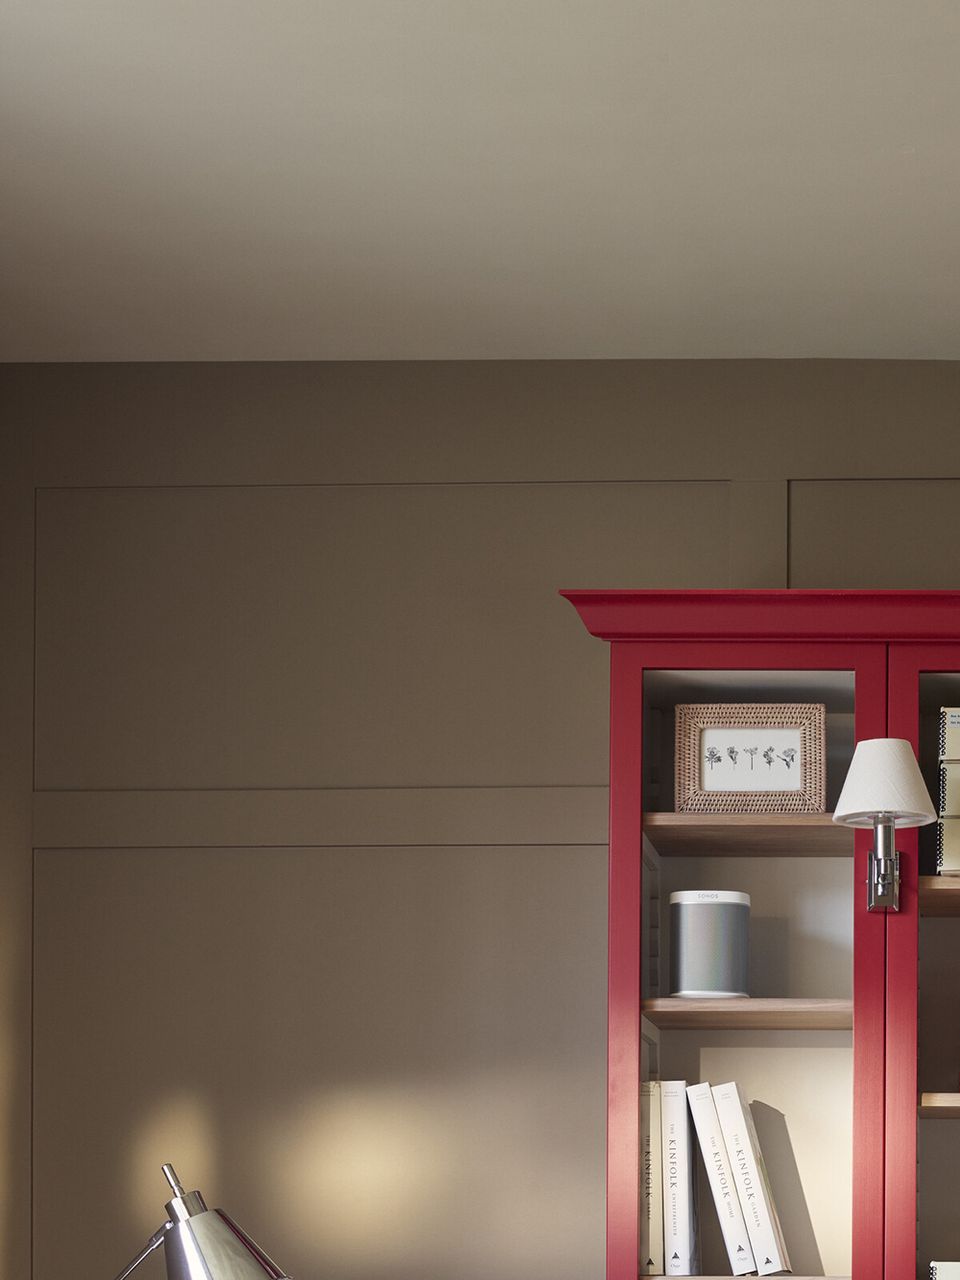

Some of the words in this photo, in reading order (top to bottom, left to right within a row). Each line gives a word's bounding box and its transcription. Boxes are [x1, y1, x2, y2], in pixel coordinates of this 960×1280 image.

[644, 1151, 653, 1199] KINFOLK
[669, 1139, 678, 1189] KINFOLK
[712, 1151, 730, 1199] KINFOLK
[736, 1149, 756, 1201] KINFOLK
